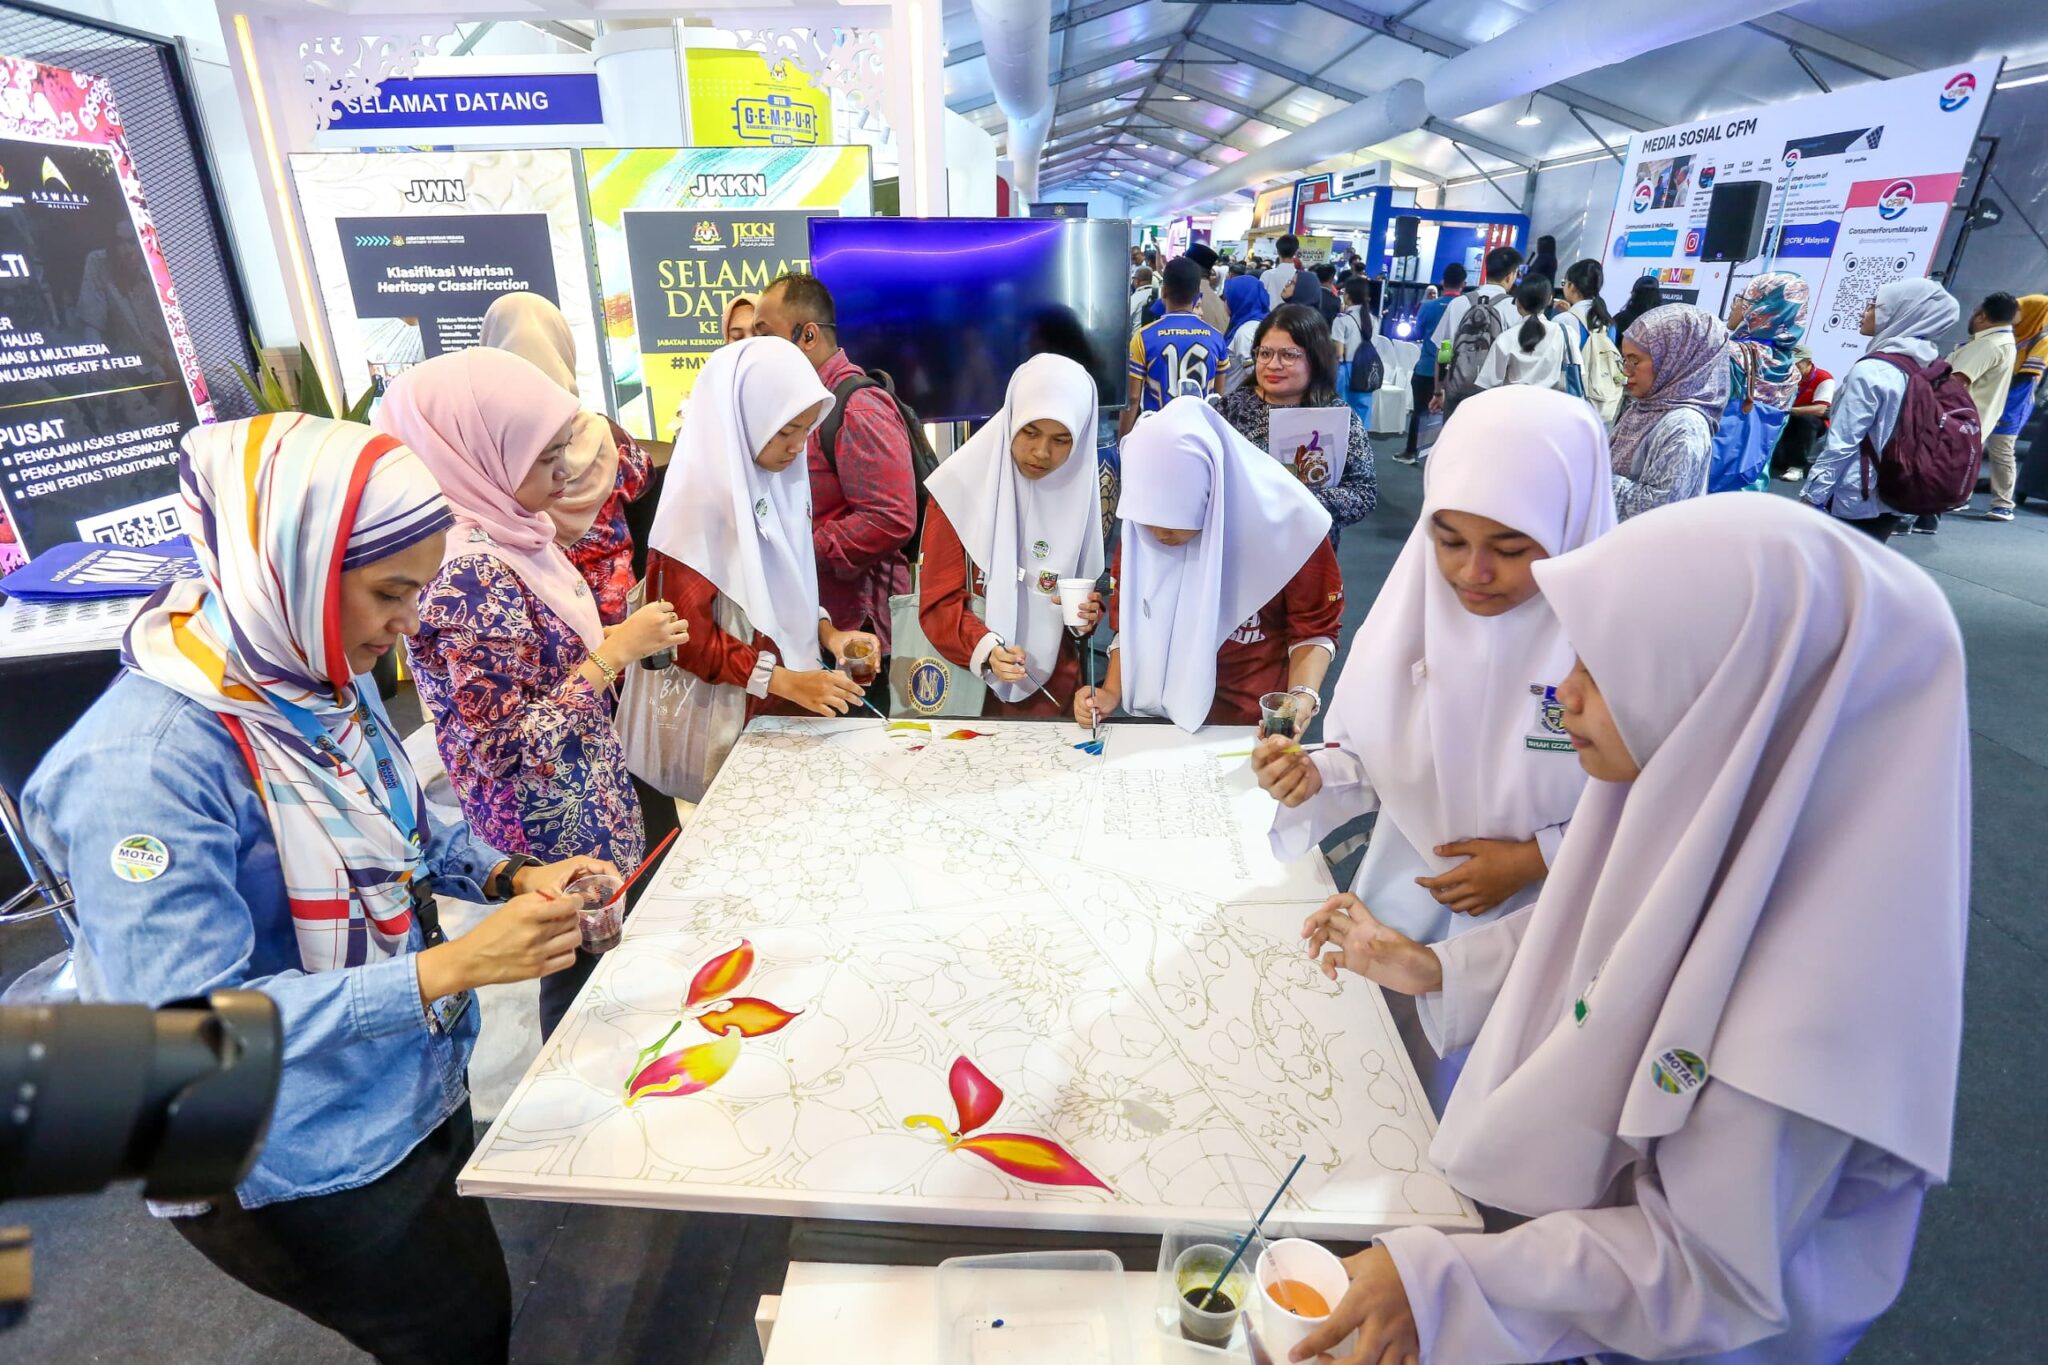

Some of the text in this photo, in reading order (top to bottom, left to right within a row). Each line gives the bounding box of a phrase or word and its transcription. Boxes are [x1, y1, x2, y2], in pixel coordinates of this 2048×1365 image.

[455, 91, 549, 112] DATANG
[1642, 117, 1758, 154] MEDIA SOSIAL CFM
[32, 190, 89, 203] ASWARA
[405, 179, 466, 202] JWN
[690, 174, 766, 197] JKKN
[731, 223, 775, 248] JKKN
[386, 263, 514, 279] Klasifikasi Warisan
[377, 278, 529, 294] Heritage Classification
[699, 321, 719, 334] KE
[1158, 328, 1211, 337] PUTRAJAYA
[1, 332, 44, 348] HALUS
[30, 349, 40, 362] &
[40, 343, 110, 361] MULTIMEDIA
[52, 359, 100, 376] KREATIF
[101, 359, 112, 370] &
[111, 355, 143, 369] FILEM
[1161, 343, 1210, 397] 16
[13, 421, 181, 466] PENGAJIAN ASASI SENI KREATIF
[19, 438, 174, 482] PENGAJIAN PASCASISWAZAH
[27, 480, 57, 498] SENI
[57, 470, 103, 491] PENTAS
[103, 455, 170, 481] TRADITIONAL
[660, 678, 697, 717] BAY
[119, 848, 164, 864] MOTAC
[1662, 1052, 1697, 1087] MOTAC
